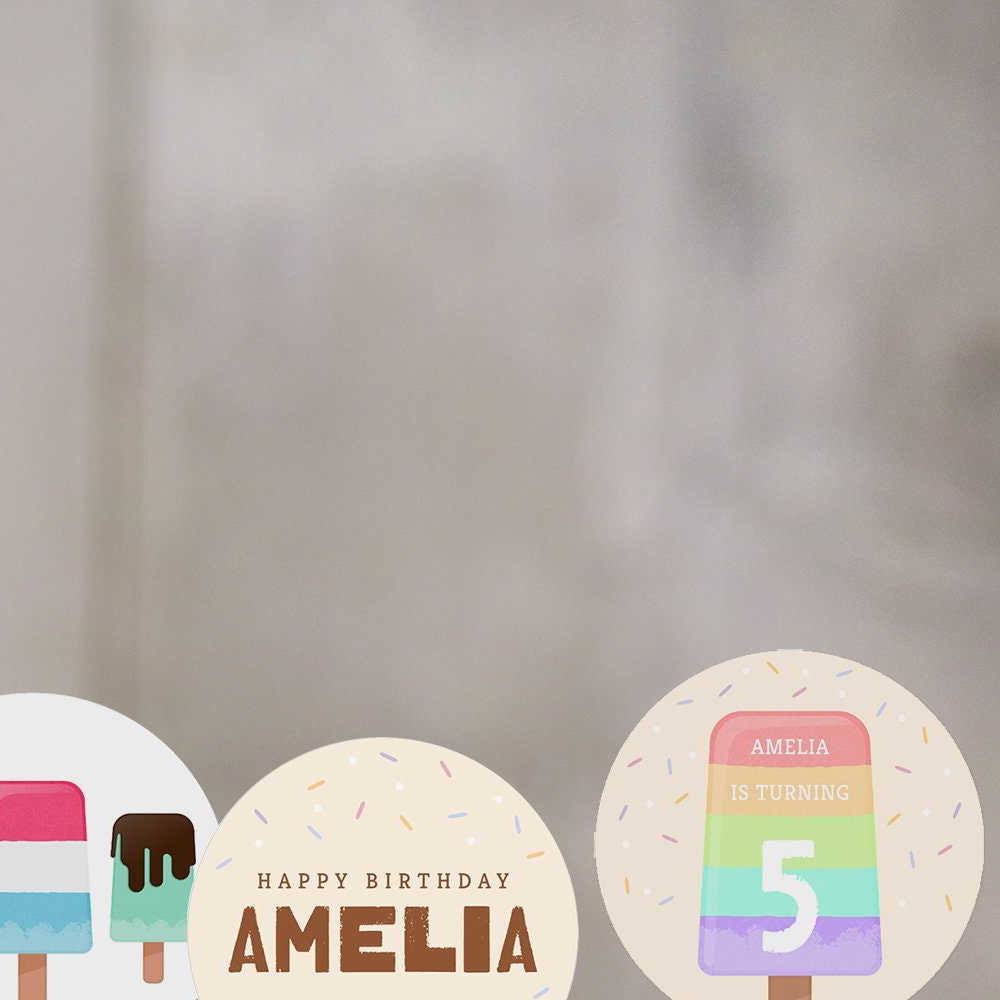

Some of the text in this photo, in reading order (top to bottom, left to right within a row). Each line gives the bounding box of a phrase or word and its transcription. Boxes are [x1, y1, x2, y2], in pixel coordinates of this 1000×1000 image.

[750, 738, 830, 756] AMELIA
[731, 784, 850, 801] IS TURNING
[257, 872, 511, 889] HAPPY BIRTHDAY
[762, 839, 819, 954] 5
[228, 905, 538, 974] AMELIA
